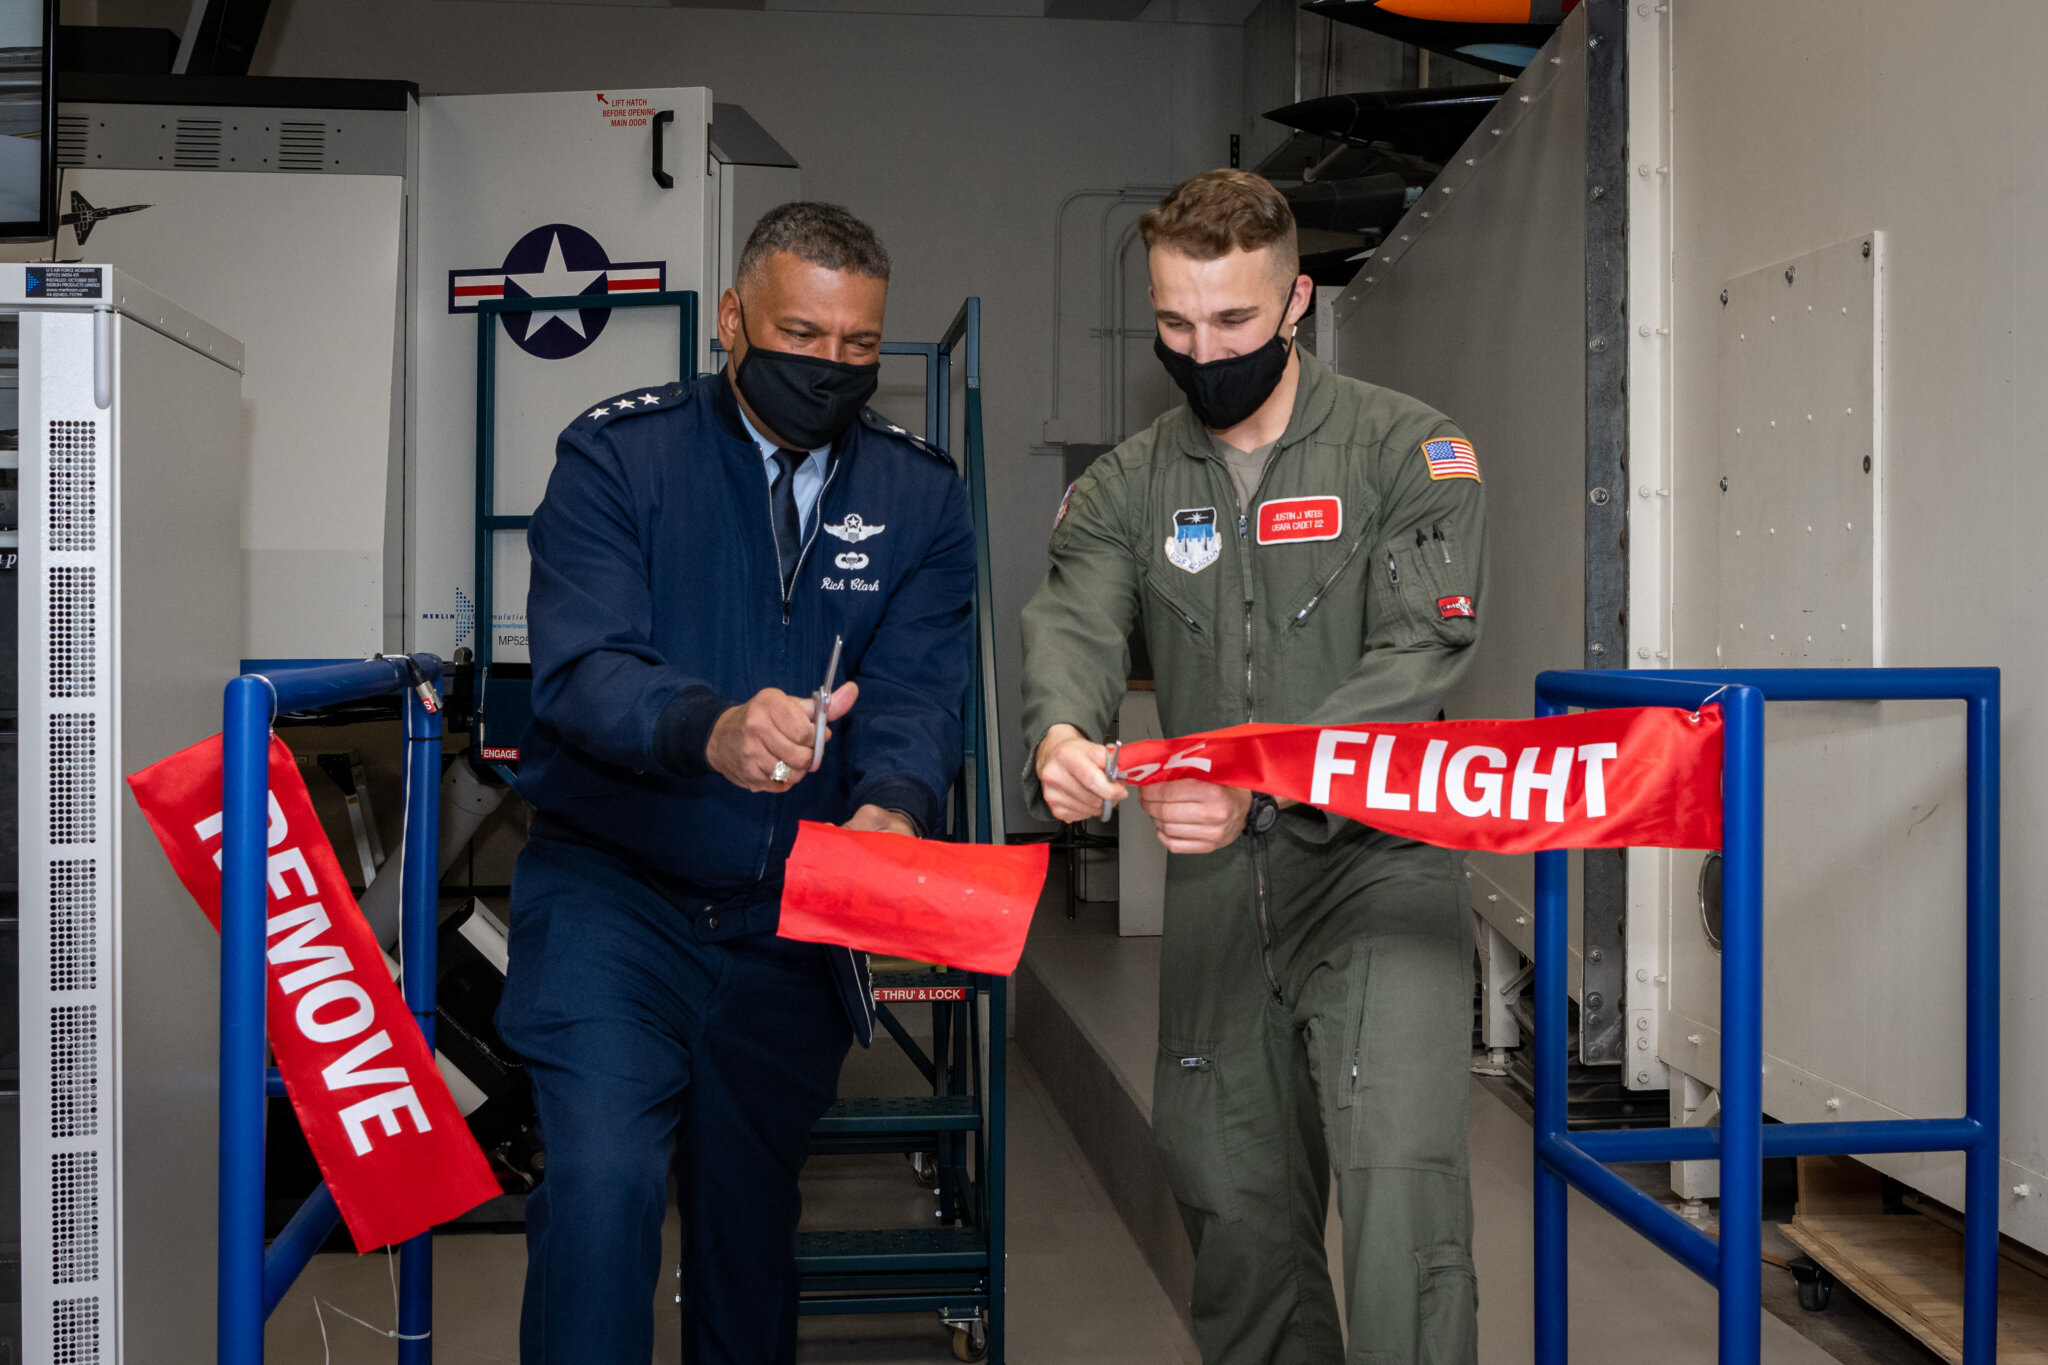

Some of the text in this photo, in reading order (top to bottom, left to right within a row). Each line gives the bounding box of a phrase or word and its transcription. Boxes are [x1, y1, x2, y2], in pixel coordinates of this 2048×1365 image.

[611, 98, 648, 107] LIFT HATCH
[602, 108, 657, 117] BEFORE OPENING
[611, 118, 647, 127] MAIN DOOR
[1272, 511, 1296, 521] JUSTIN
[1304, 510, 1323, 519] YATES
[1272, 520, 1324, 532] USAFA CADET 22
[820, 577, 880, 591] Rich Clark
[483, 749, 518, 759] ENGAGE
[1309, 729, 1618, 823] FLIGHT
[918, 989, 927, 1000] &
[929, 989, 961, 1000] LOCK
